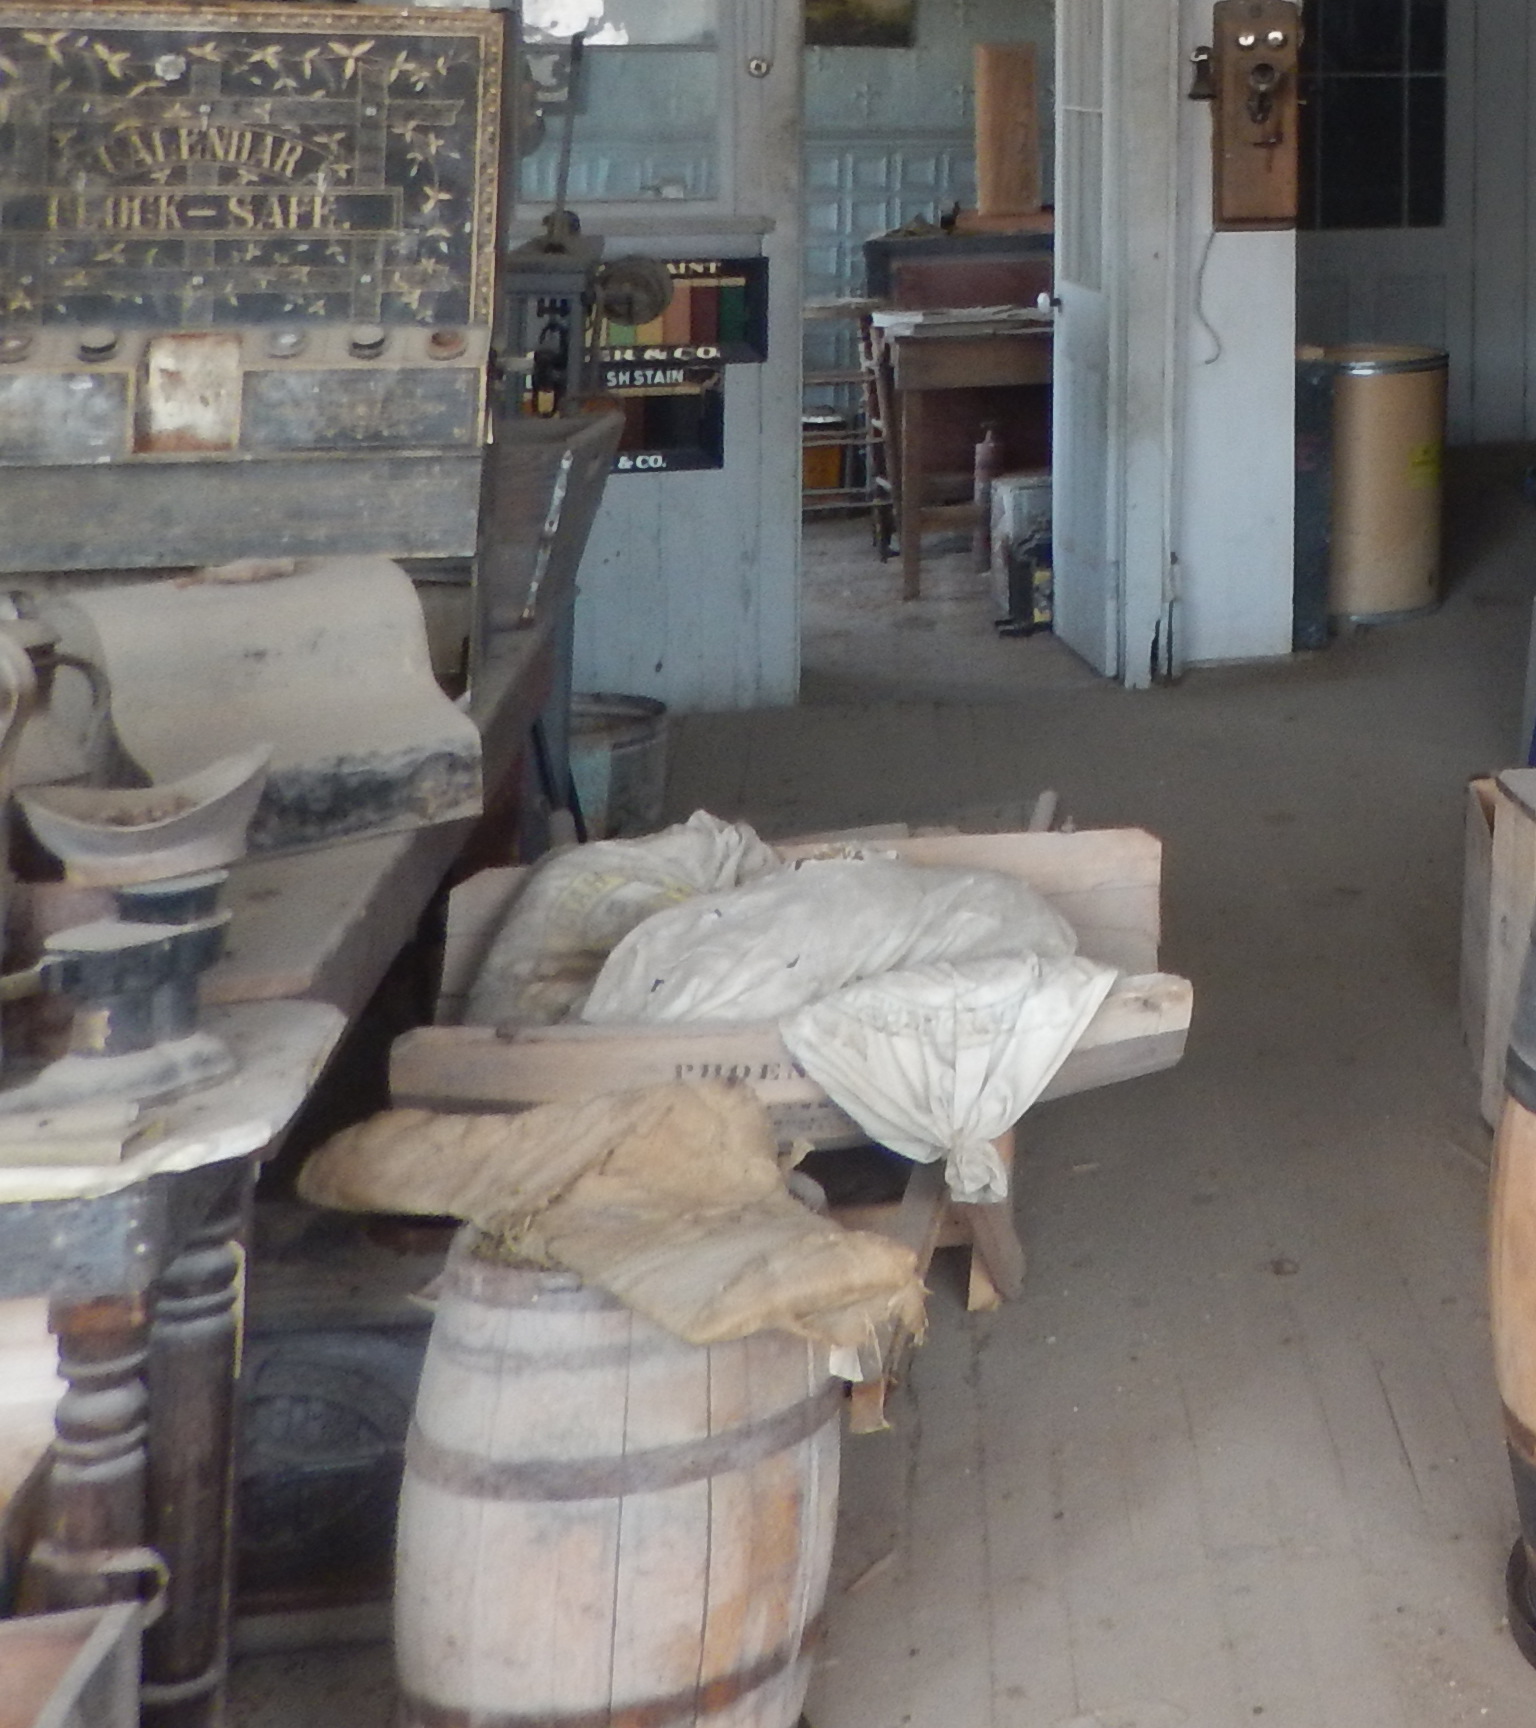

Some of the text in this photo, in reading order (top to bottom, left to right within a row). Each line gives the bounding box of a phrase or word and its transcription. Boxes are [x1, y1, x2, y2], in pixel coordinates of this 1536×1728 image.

[100, 127, 303, 178] CALENDAR
[643, 347, 667, 361] &
[633, 368, 685, 386] STAIN
[617, 454, 668, 470] & CO.
